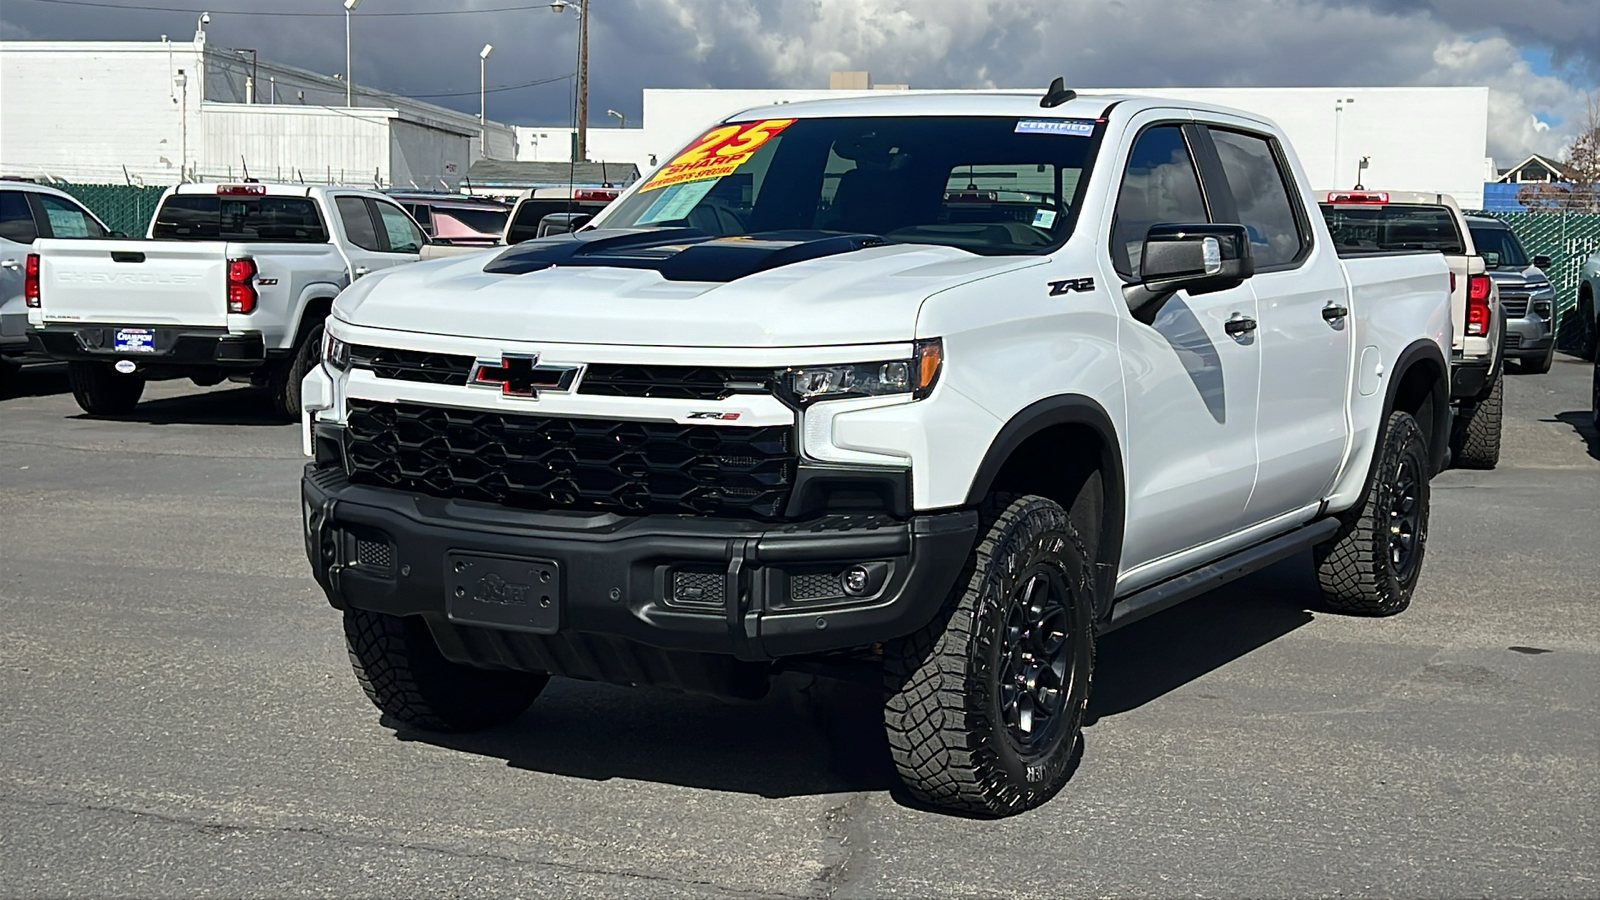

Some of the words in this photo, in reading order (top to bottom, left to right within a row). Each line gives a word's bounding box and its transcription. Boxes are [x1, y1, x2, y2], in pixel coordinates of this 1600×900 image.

[1019, 121, 1091, 132] CERTIFIED
[671, 119, 794, 166] 25
[665, 153, 746, 176] SHARP
[694, 165, 734, 177] SPECIAL
[56, 270, 203, 286] CHEVROLET
[1047, 277, 1096, 297] ZR2
[686, 411, 741, 421] ZR2
